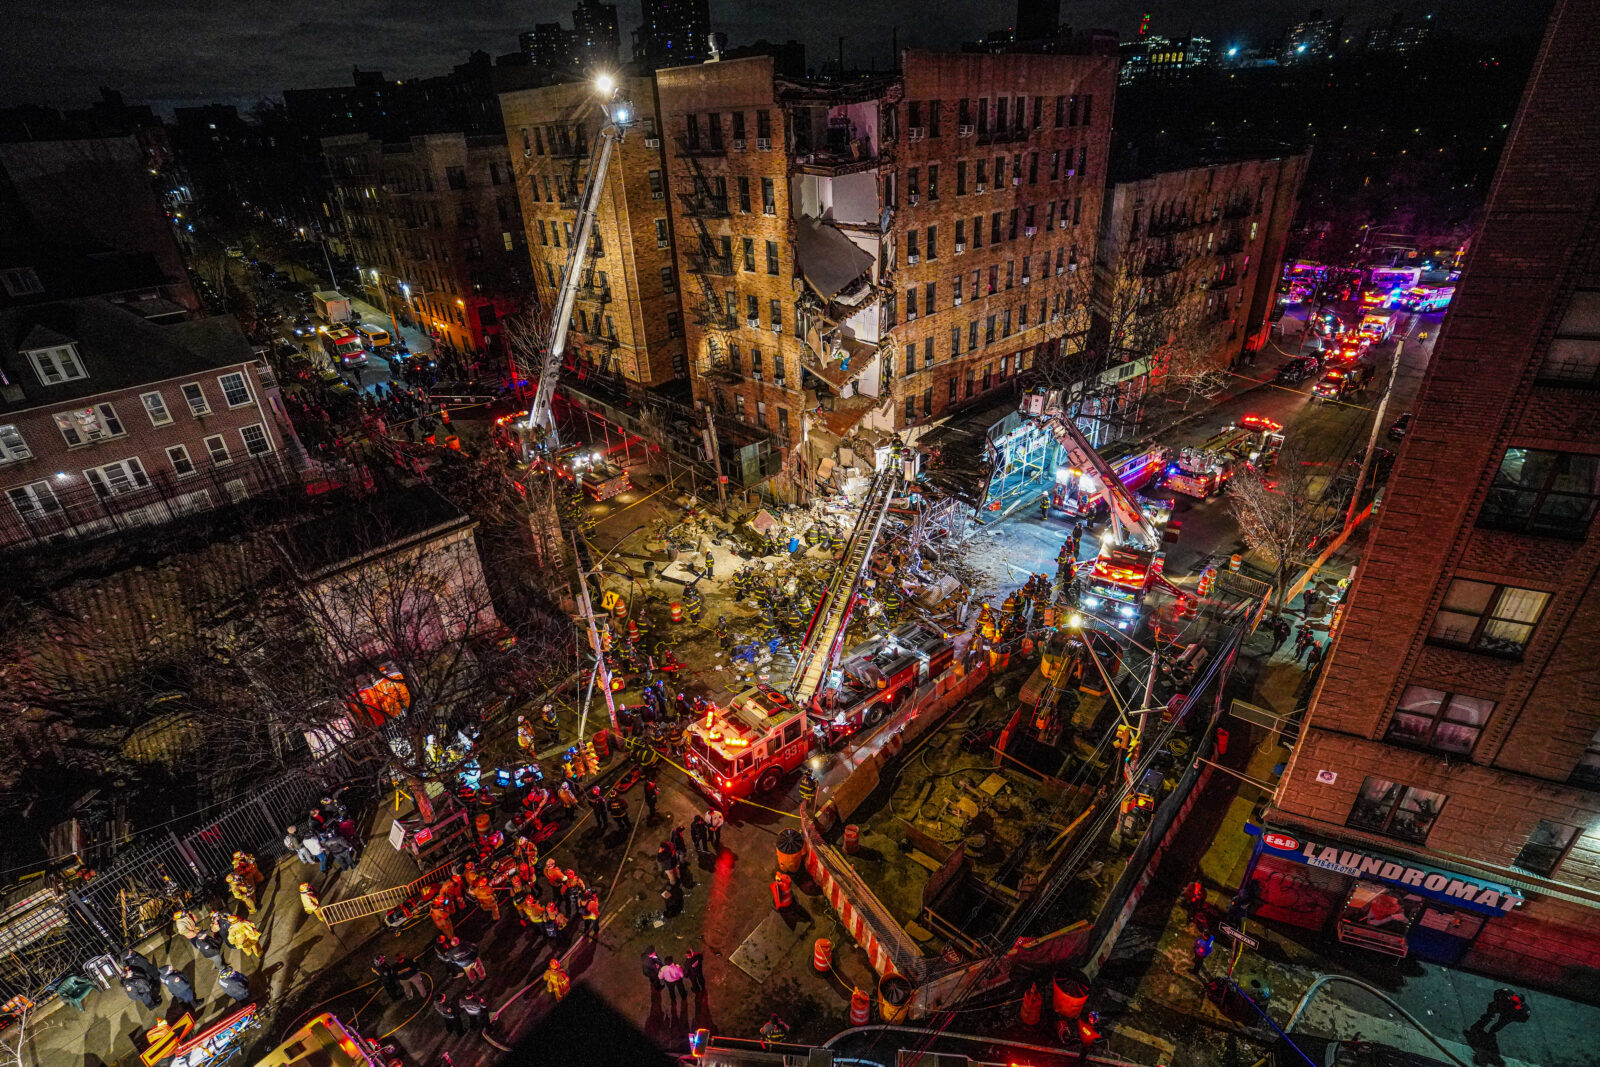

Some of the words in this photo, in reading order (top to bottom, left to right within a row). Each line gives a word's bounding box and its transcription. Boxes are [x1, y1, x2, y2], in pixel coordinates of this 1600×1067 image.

[785, 744, 798, 760] 93
[1266, 835, 1296, 848] E&B
[1303, 841, 1522, 912] LAUNDROMAT
